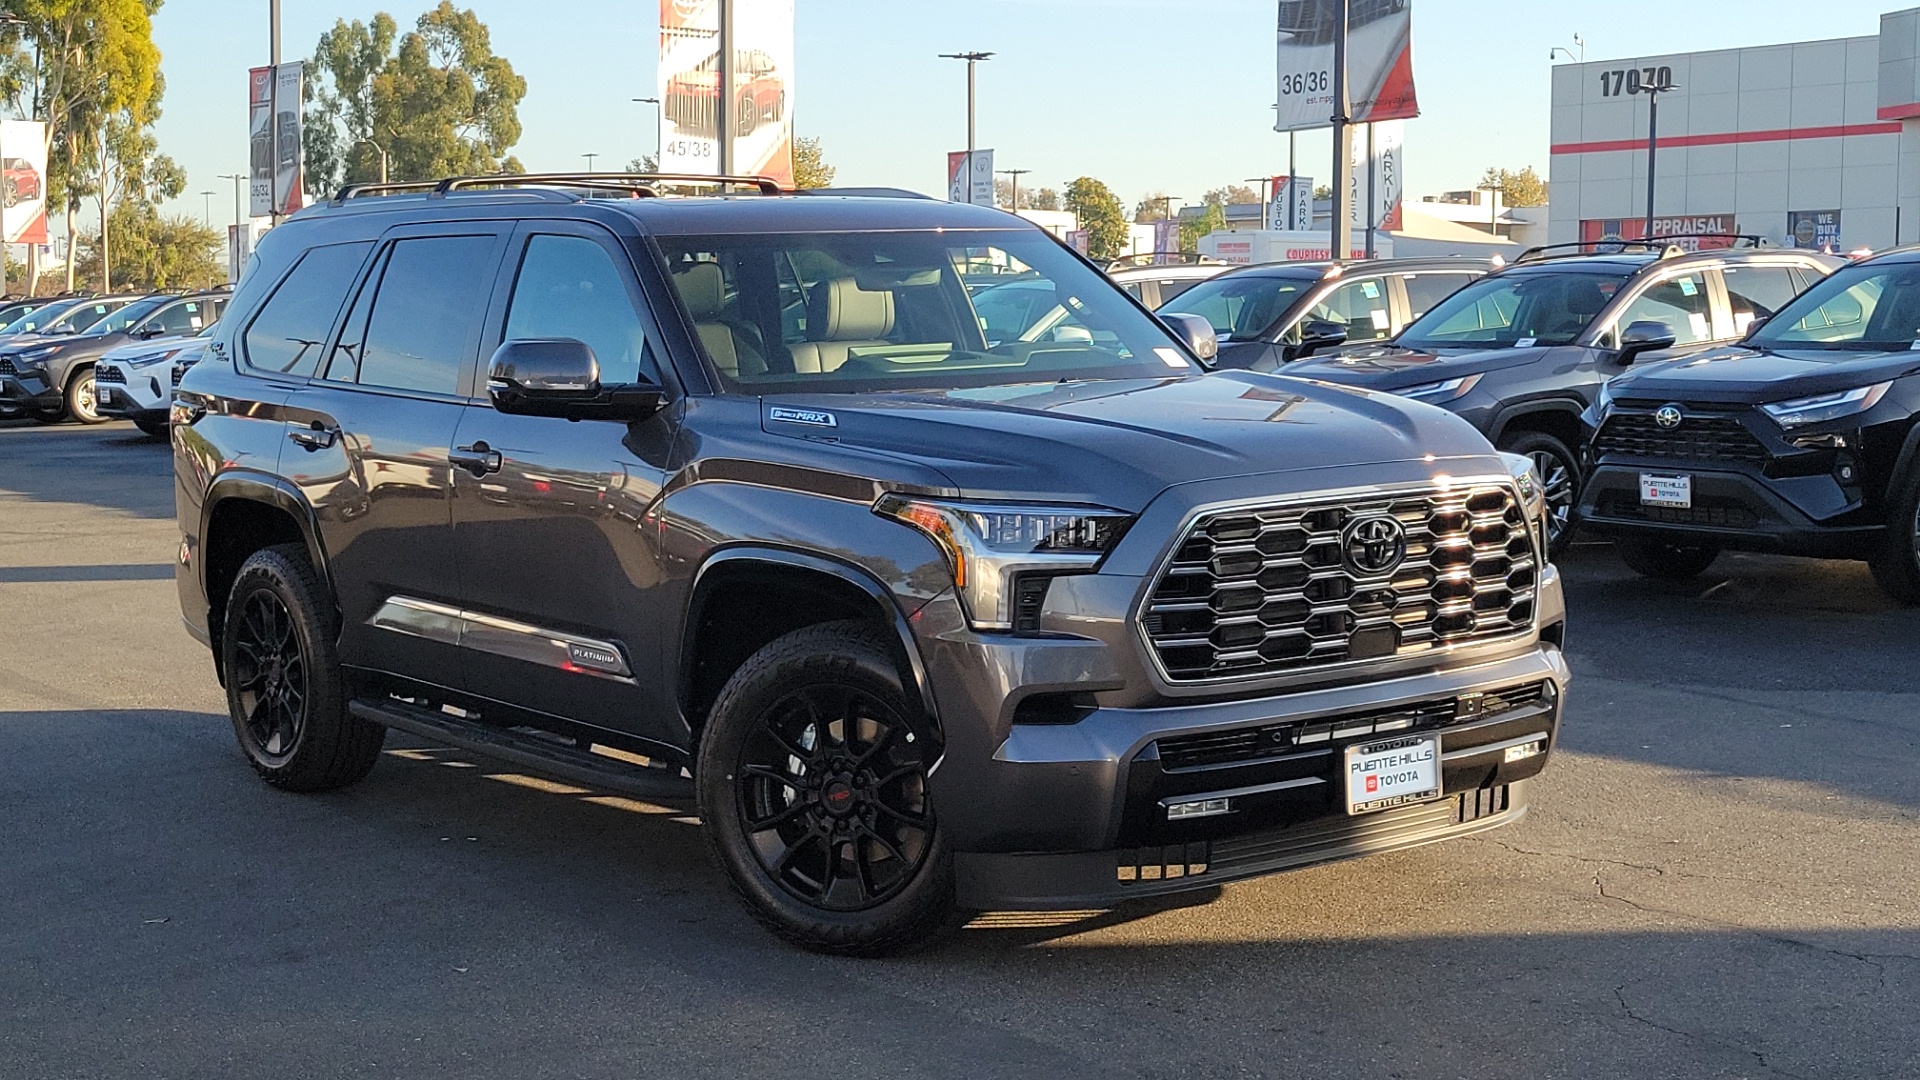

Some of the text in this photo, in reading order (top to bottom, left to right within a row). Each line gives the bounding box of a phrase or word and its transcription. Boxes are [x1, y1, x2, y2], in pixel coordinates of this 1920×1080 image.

[1281, 70, 1328, 95] 36/36
[1600, 66, 1671, 97] 17070
[667, 140, 711, 157] 45/38
[1818, 213, 1833, 224] WE
[1817, 224, 1837, 235] BUY
[1817, 235, 1841, 246] CARS
[1286, 249, 1330, 260] COURTESY
[796, 412, 826, 423] MAX
[574, 649, 614, 662] PLATINUM
[1369, 738, 1417, 752] TOYOTA
[1351, 750, 1433, 774] PUENTE HILLS
[1379, 770, 1419, 787] TOYOTA
[1354, 790, 1437, 812] PUENTE HILLS
